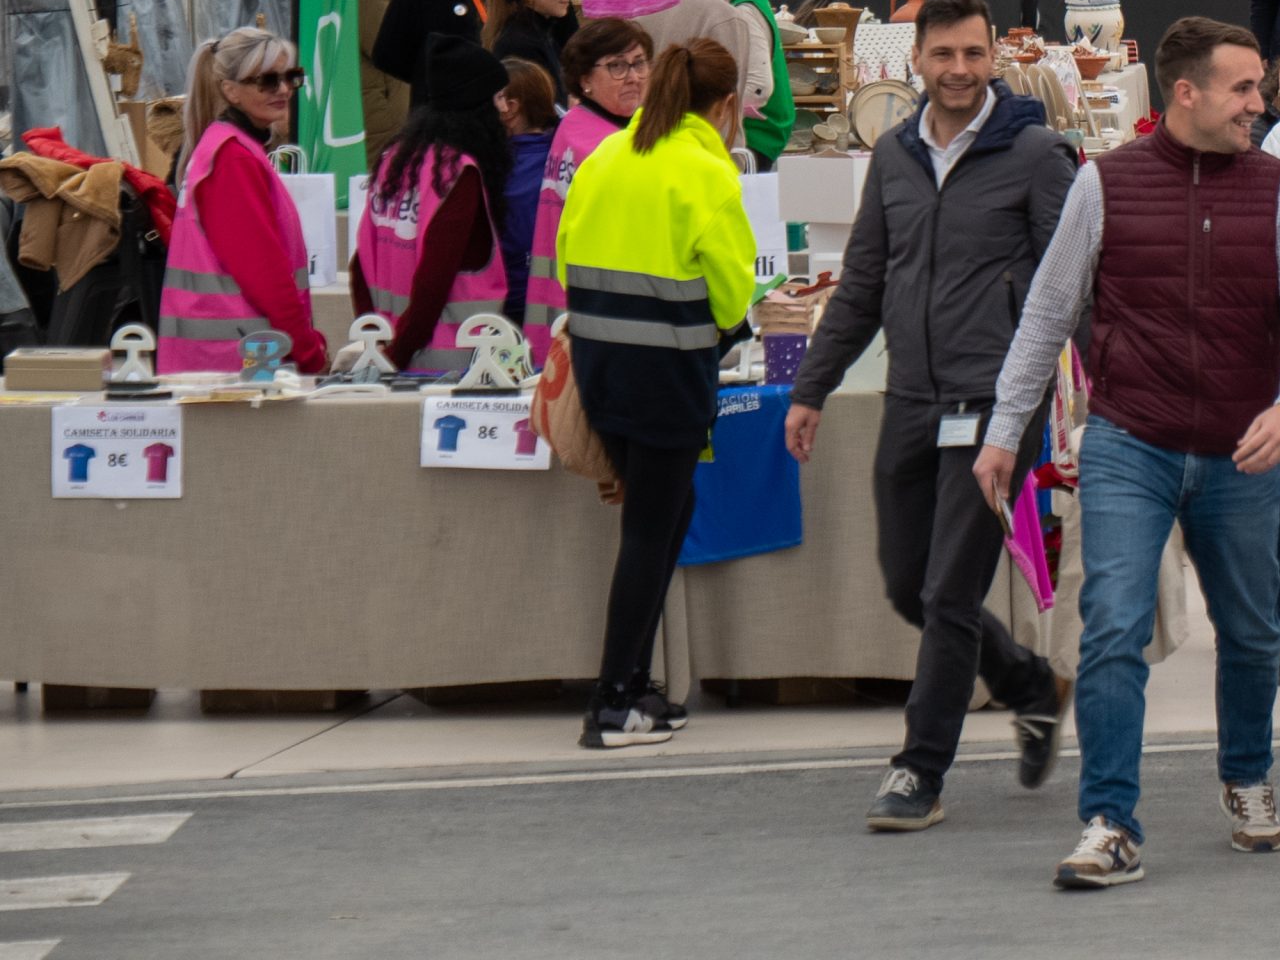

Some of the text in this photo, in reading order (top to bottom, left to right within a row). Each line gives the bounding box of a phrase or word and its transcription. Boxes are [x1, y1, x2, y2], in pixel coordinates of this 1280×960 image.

[435, 400, 490, 411] CAMISETA
[63, 428, 176, 438] CAMISETA SOLIDARIA
[478, 425, 498, 440] 8€
[107, 452, 128, 468] 8€
